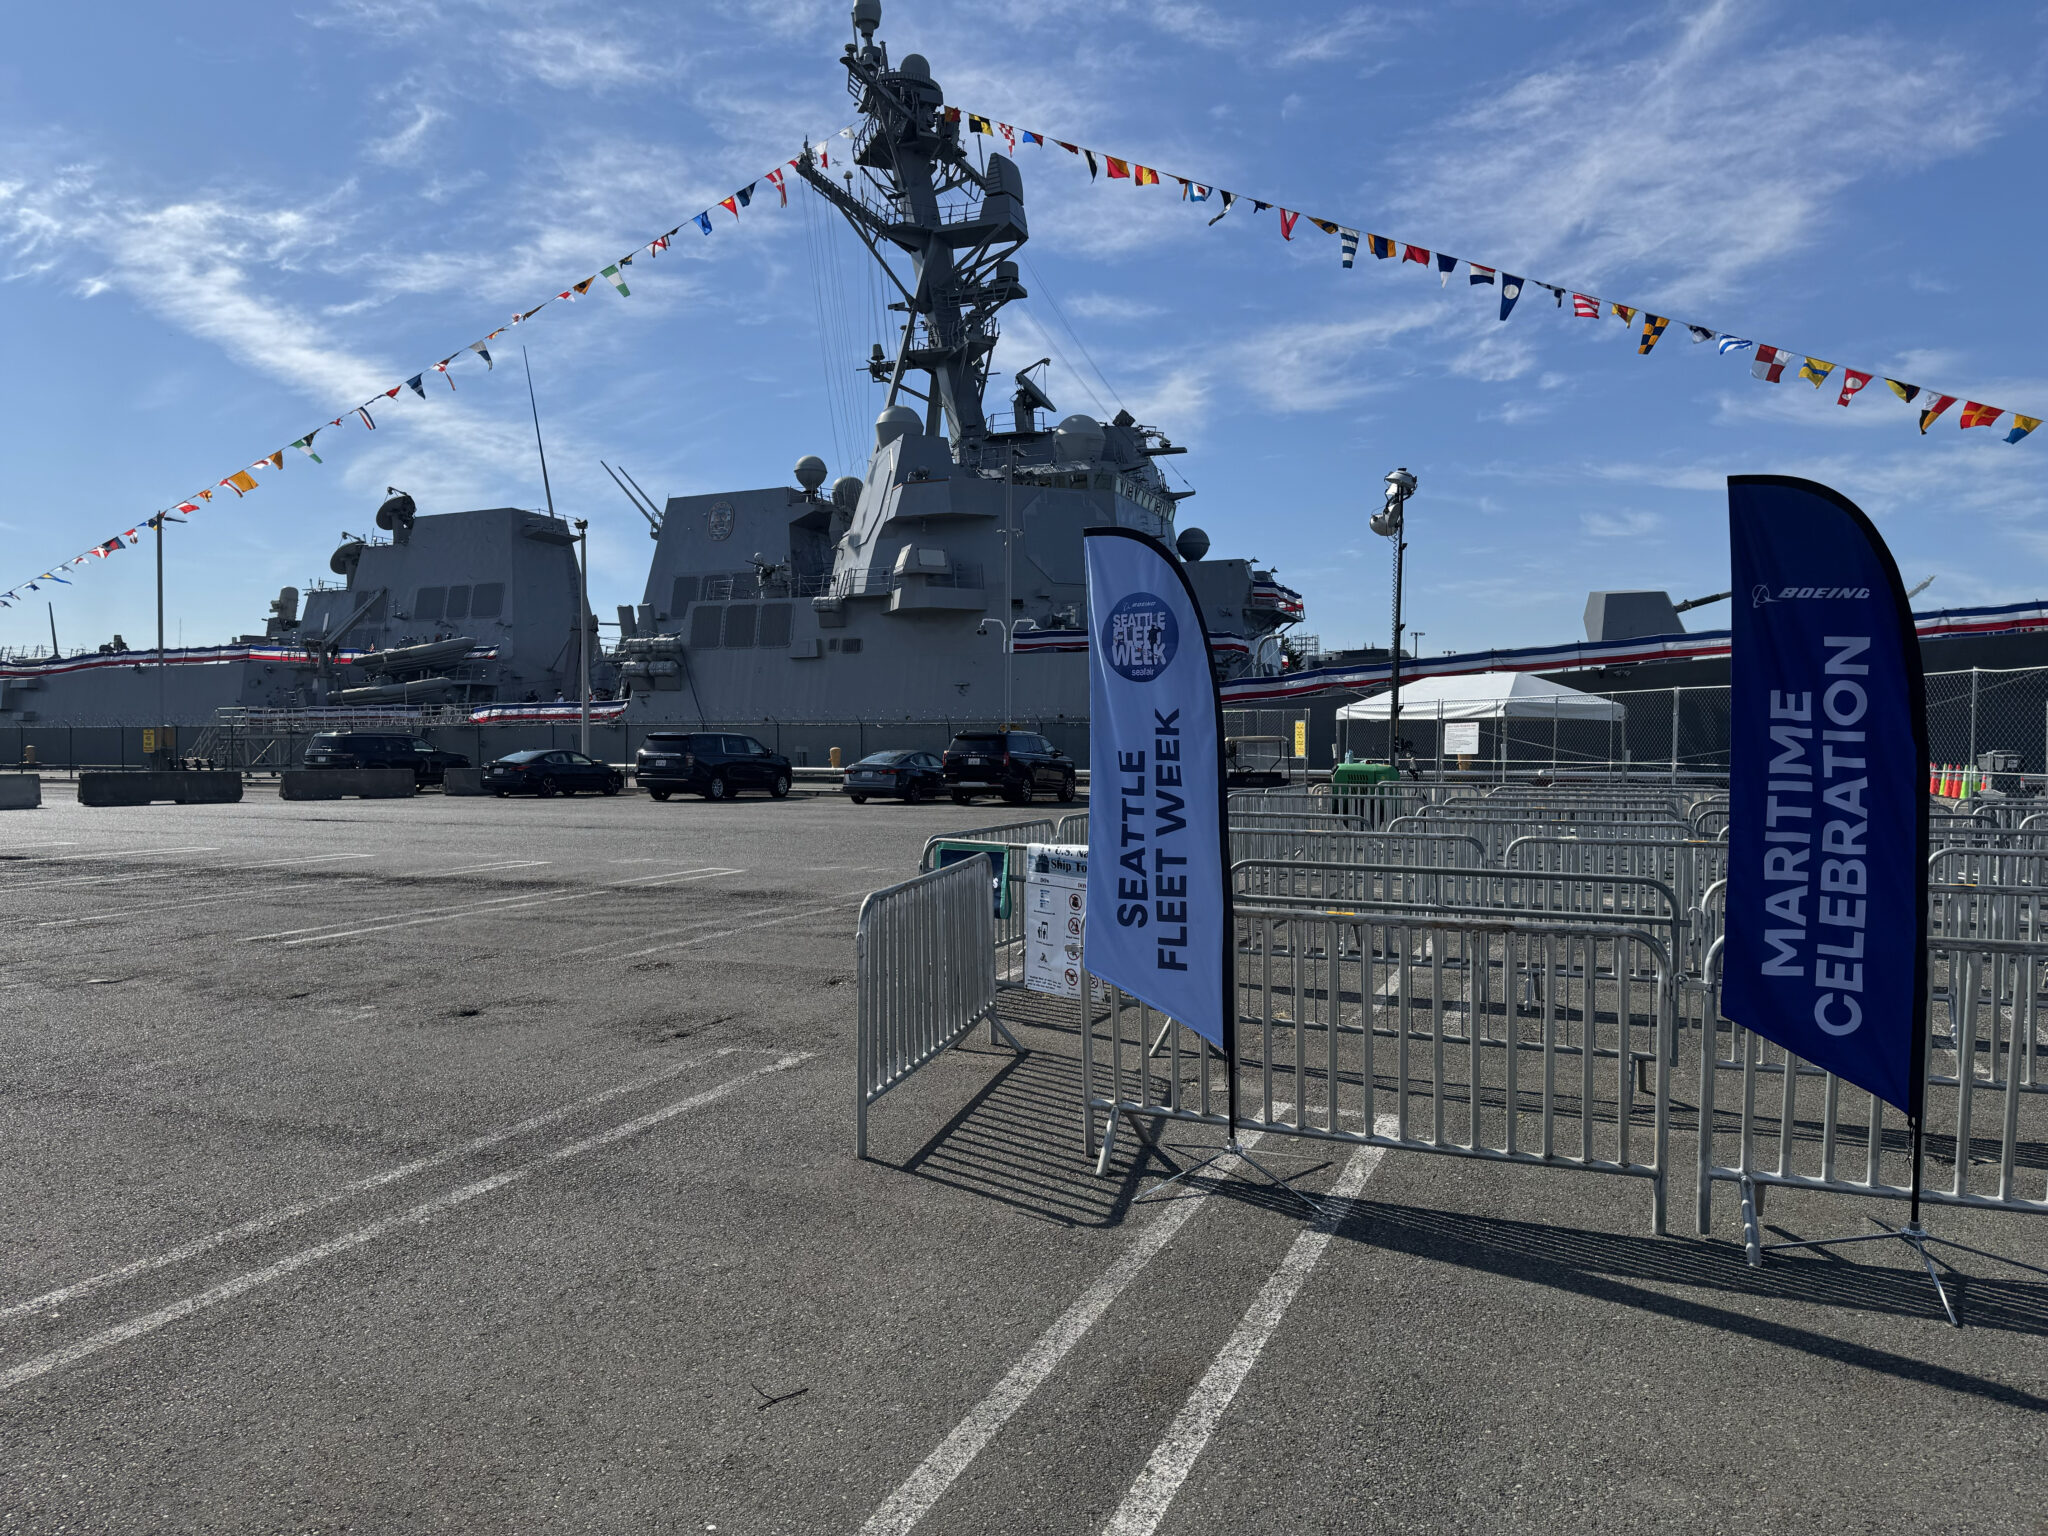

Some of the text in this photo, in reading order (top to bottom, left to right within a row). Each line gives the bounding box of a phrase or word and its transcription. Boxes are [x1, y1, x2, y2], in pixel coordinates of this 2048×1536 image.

[1113, 612, 1166, 630] SEATTLE
[1777, 587, 1870, 599] BOEING
[1112, 642, 1167, 666] WEEK
[1051, 858, 1087, 873] Ship To
[1116, 749, 1149, 928] SEATTLE
[1154, 708, 1188, 971] FLEET WEEK
[1761, 689, 1812, 977] MARITIME
[1813, 635, 1872, 1037] CELEBRATION
